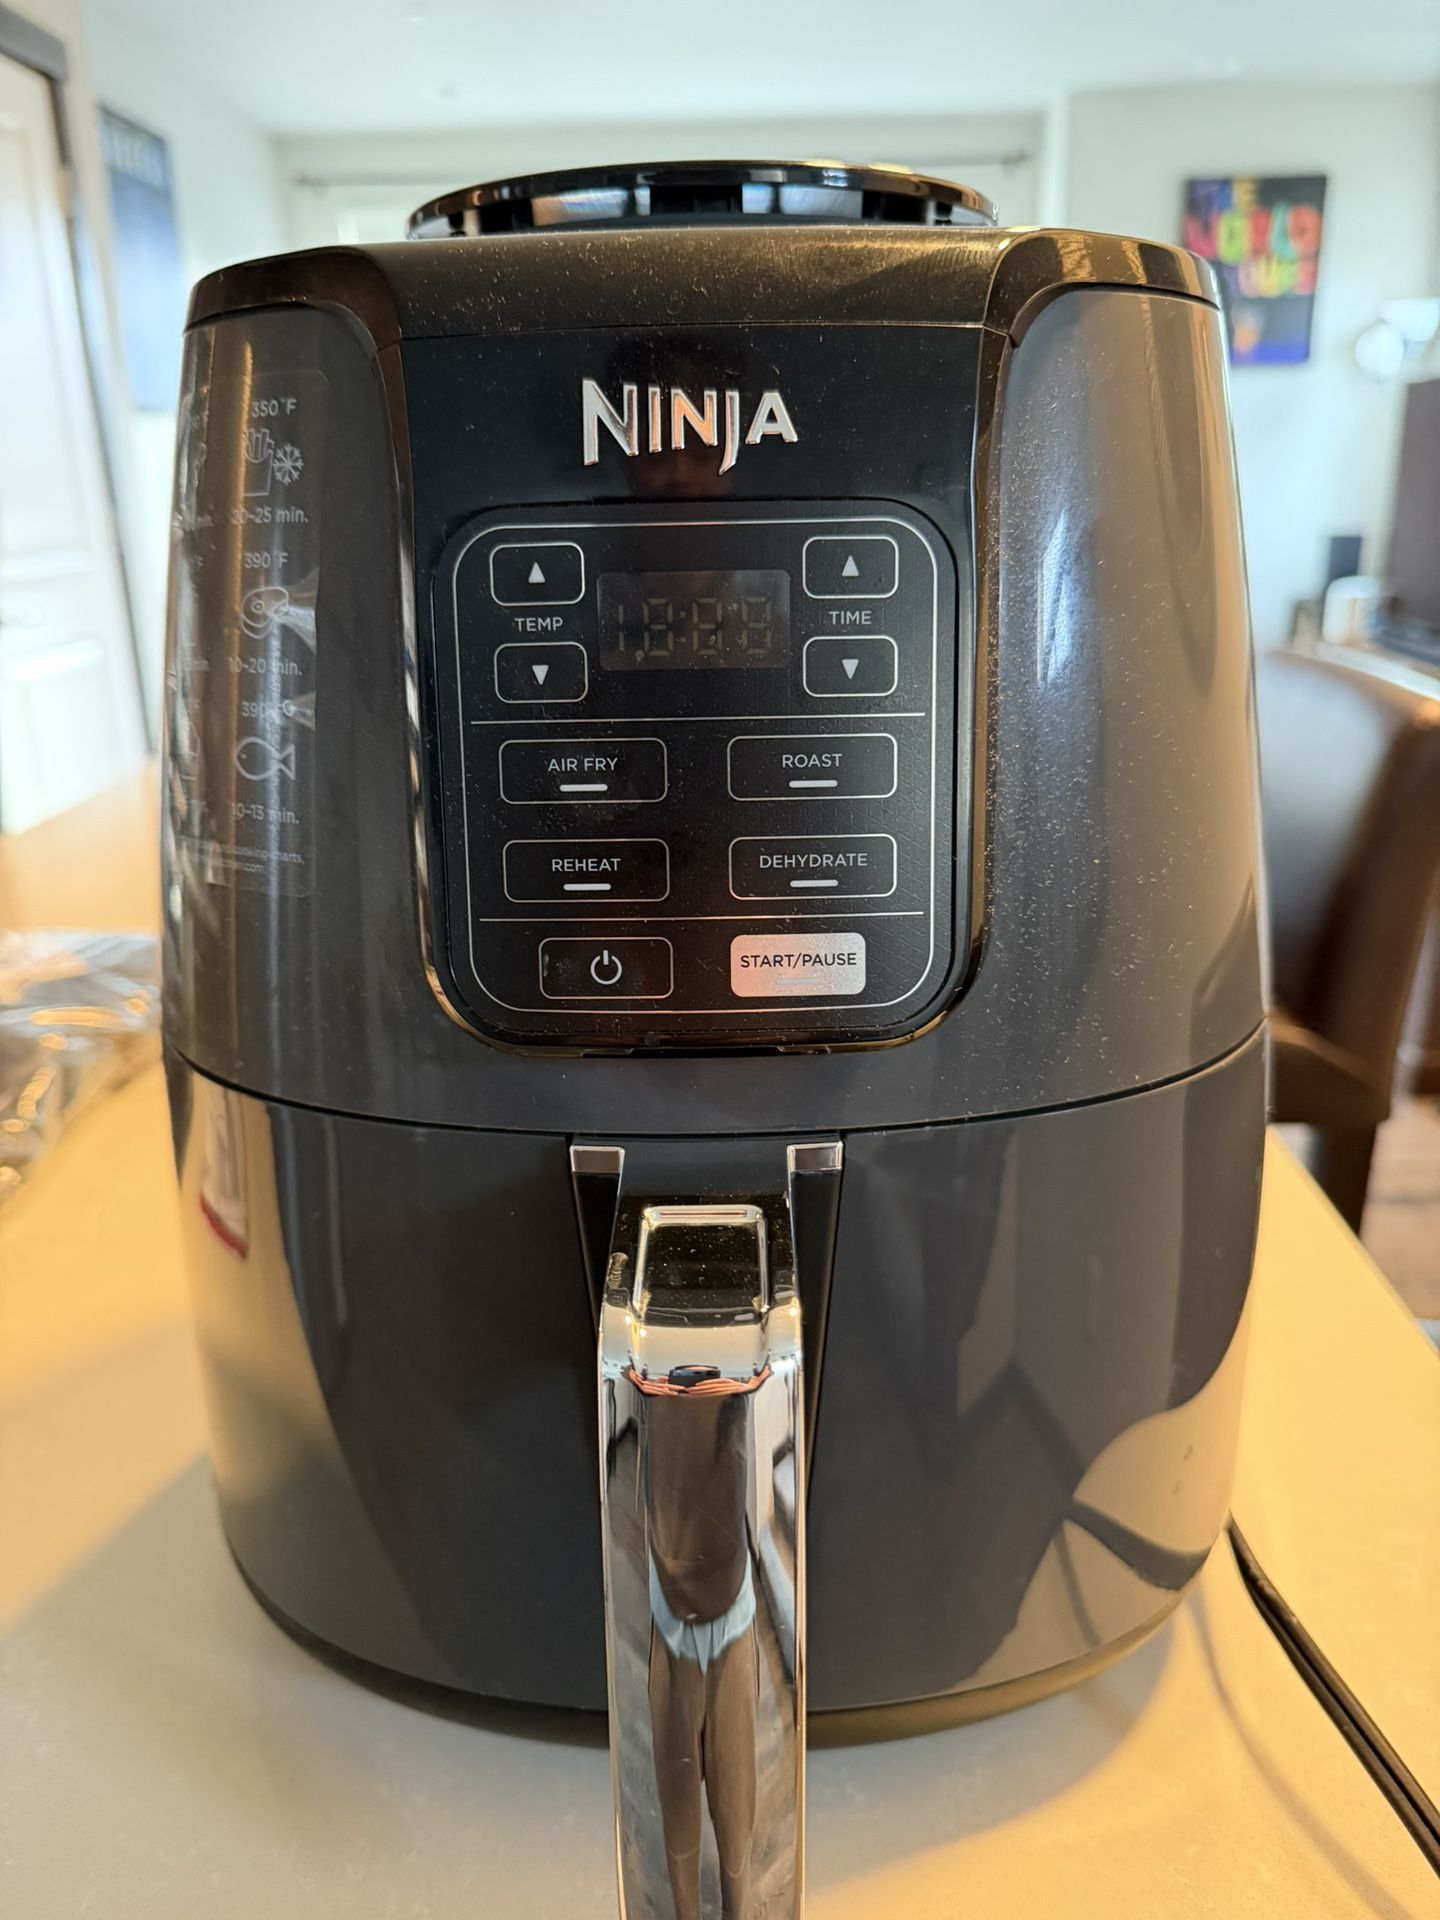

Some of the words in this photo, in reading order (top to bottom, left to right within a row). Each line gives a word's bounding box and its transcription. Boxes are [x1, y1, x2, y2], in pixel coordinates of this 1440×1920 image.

[582, 377, 798, 475] NINJA
[276, 505, 308, 523] min.
[514, 616, 563, 632] TEMP
[829, 610, 872, 626] TIME
[547, 758, 578, 772] AIR
[584, 757, 618, 772] FRY
[782, 753, 843, 768] ROAST
[551, 858, 621, 872] REHEAT
[759, 853, 868, 869] DEHYDRATE
[740, 952, 857, 969] START/PAUSE
